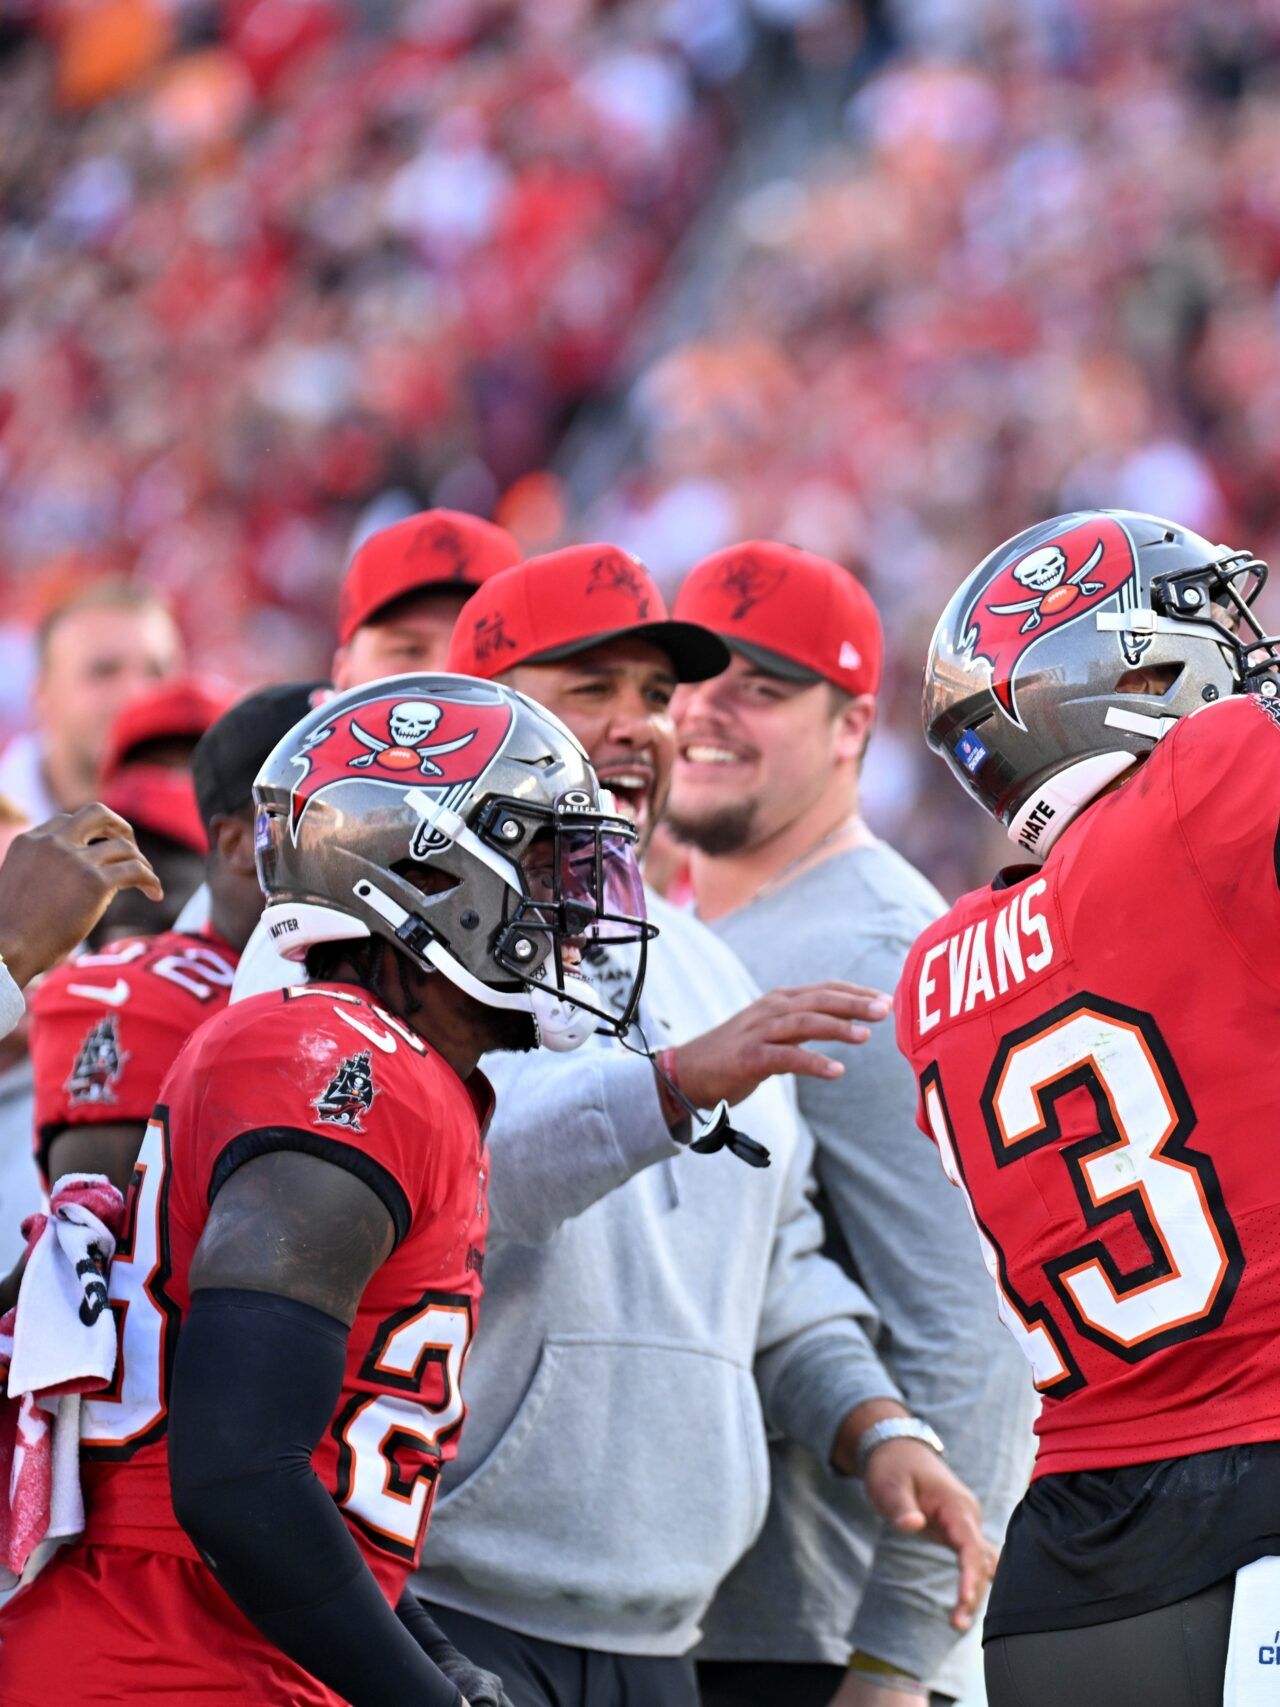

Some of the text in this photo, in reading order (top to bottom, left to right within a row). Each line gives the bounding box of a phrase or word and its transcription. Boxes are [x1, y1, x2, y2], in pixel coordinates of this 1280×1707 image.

[1019, 800, 1056, 844] HATE
[918, 878, 1053, 1036] EVANS
[919, 990, 1246, 1400] 13
